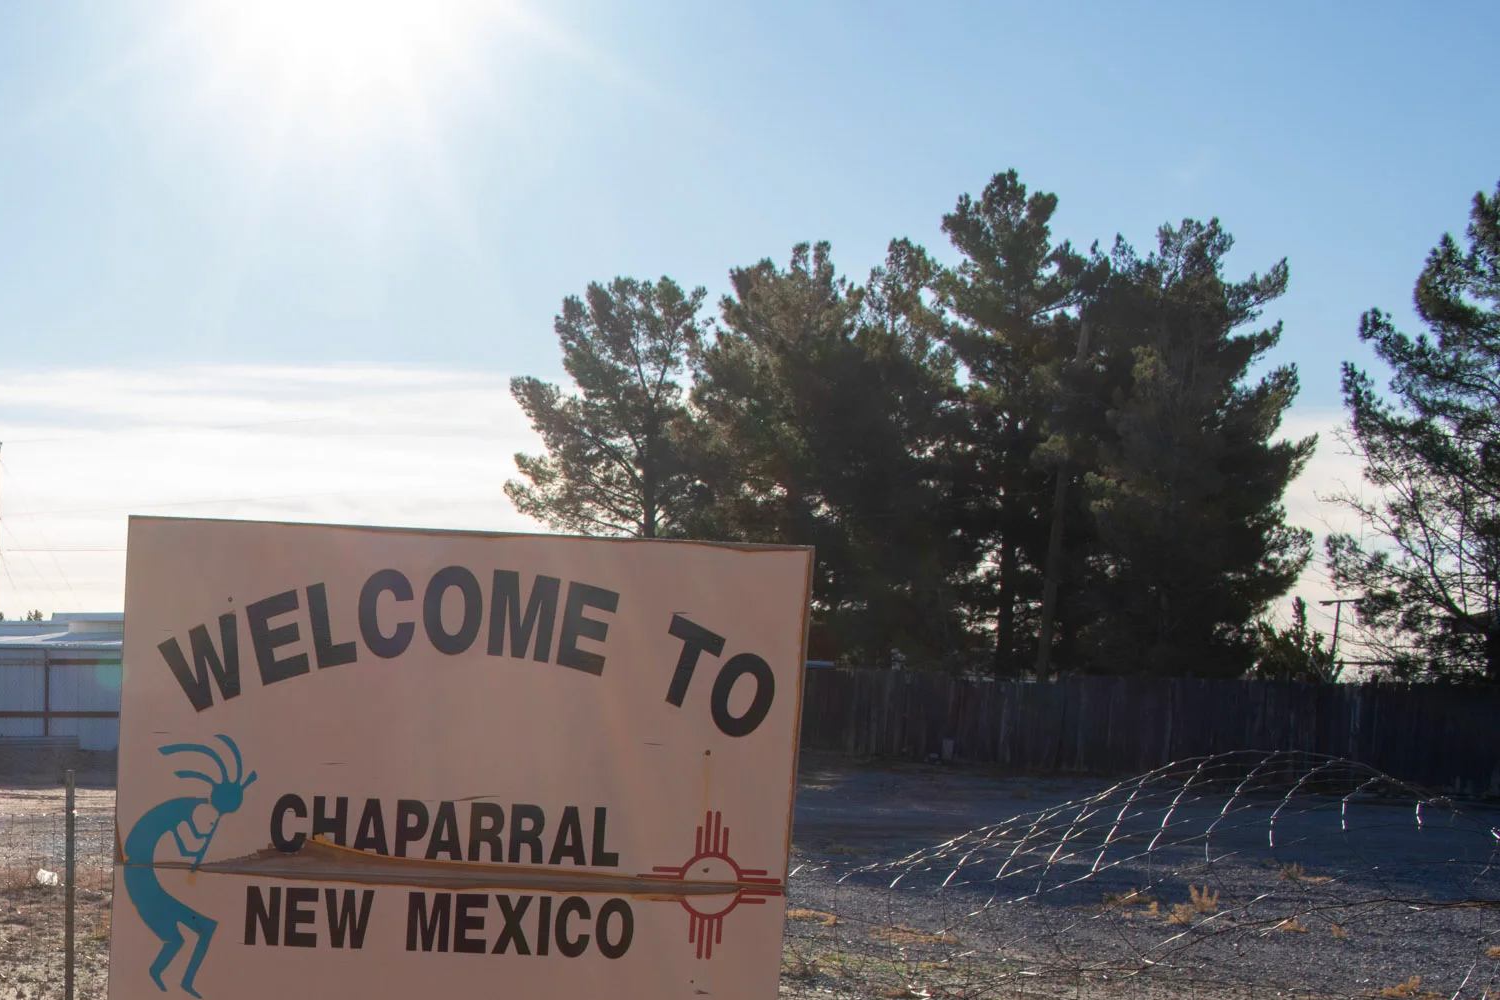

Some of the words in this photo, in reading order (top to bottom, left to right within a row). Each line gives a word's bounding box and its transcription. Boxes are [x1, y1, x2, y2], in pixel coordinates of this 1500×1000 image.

[157, 565, 620, 713] WELCOME
[664, 614, 776, 738] TO
[269, 793, 620, 868] CHAPARRAL
[243, 885, 375, 949] NEW
[405, 891, 635, 959] MEXICO
